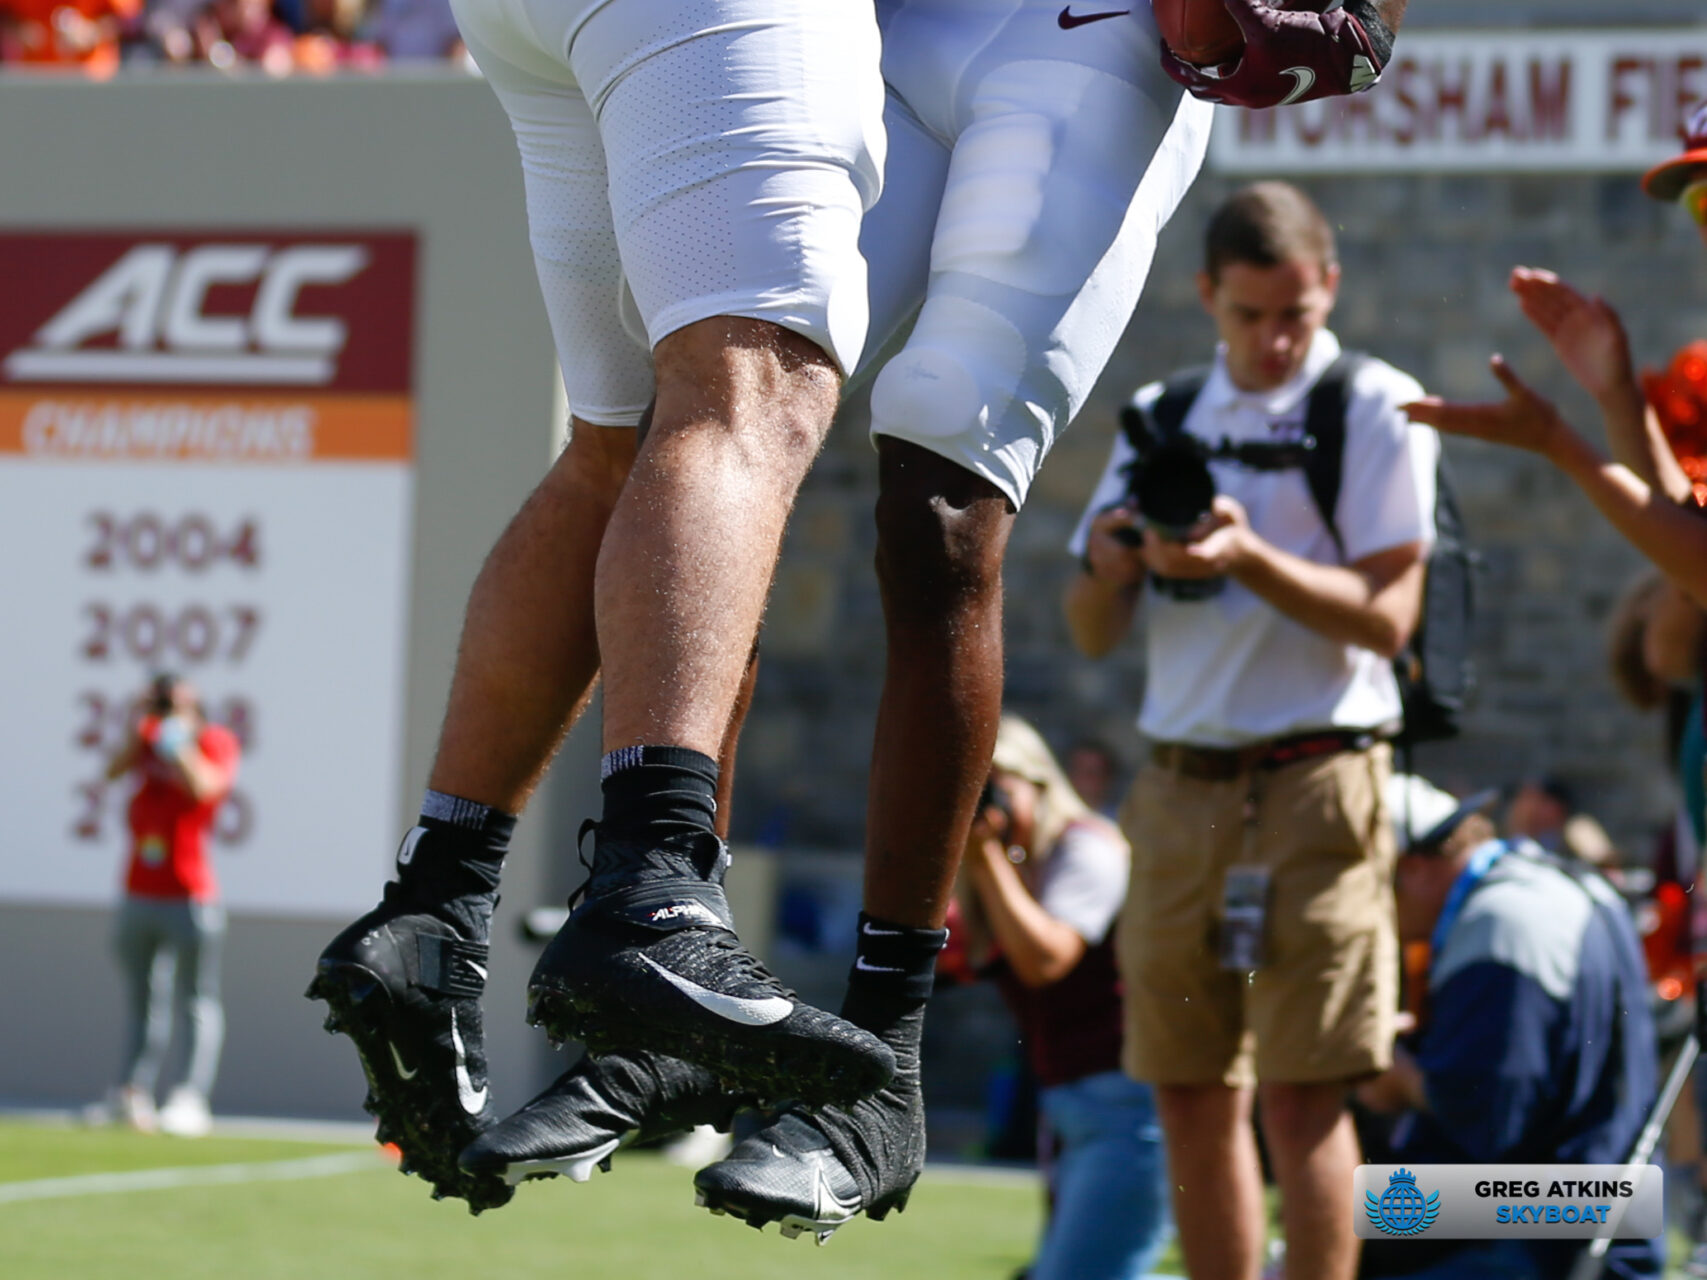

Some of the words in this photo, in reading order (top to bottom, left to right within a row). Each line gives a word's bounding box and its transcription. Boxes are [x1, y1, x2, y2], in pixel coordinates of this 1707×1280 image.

[33, 243, 372, 352] ACC
[83, 510, 263, 575] 2004
[81, 602, 264, 664] 2007
